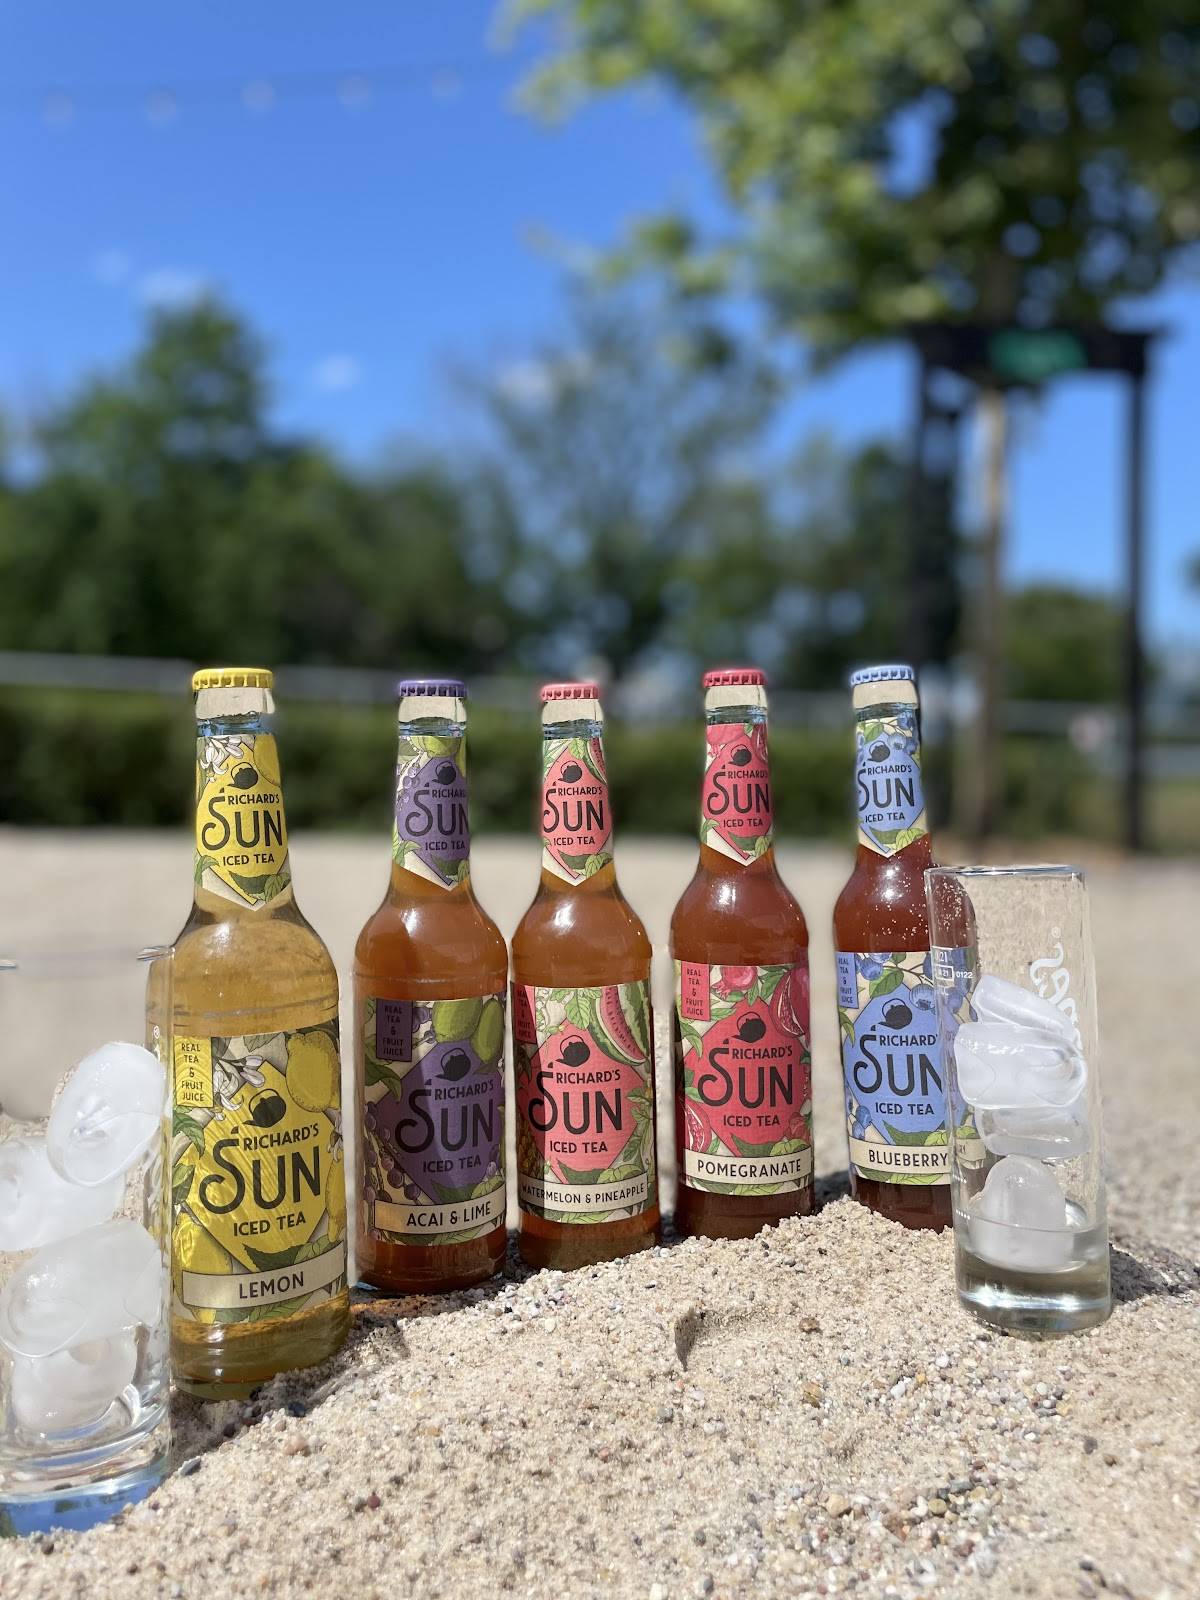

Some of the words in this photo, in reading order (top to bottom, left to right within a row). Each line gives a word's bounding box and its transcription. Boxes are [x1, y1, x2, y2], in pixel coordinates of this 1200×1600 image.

[868, 764, 913, 775] RICHARD'S
[557, 786, 603, 796] RICHARD'S
[707, 771, 770, 815] SUN
[857, 768, 915, 811] SUN
[228, 793, 280, 806] RICHARD'S
[405, 789, 470, 837] SUN
[543, 788, 604, 833] SUN
[865, 813, 884, 823] ICED
[886, 812, 906, 821] TEA
[201, 795, 284, 851] SUN
[723, 819, 744, 828] ICED
[746, 818, 764, 827] TEA
[425, 841, 448, 851] ICED
[450, 840, 466, 850] TEA
[553, 837, 574, 846] ICED
[576, 836, 596, 845] TEA
[222, 854, 250, 867] ICED
[253, 853, 275, 865] TEA
[686, 968, 702, 977] REAL
[955, 971, 973, 979] 0122
[688, 977, 700, 985] TEA
[685, 997, 704, 1007] FRUIT
[686, 1007, 704, 1016] JUICE
[386, 1015, 401, 1024] TEA
[181, 1043, 201, 1052] REAL
[879, 1034, 938, 1047] RICHARD'
[183, 1054, 199, 1063] TEA
[732, 1045, 793, 1060] RICHARD'S
[189, 1067, 195, 1078] &
[556, 1069, 621, 1085] RICHARD'S
[697, 1047, 793, 1109] SUN
[181, 1080, 204, 1091] FRUIT
[434, 1079, 494, 1101] RICHARD'S
[182, 1093, 204, 1102] JUICE
[527, 1071, 623, 1135] SUN
[875, 1102, 903, 1115] ICED
[907, 1103, 935, 1115] TEA
[395, 1089, 494, 1154] SUN
[723, 1115, 752, 1128] ICED
[756, 1115, 781, 1127] TEA
[243, 1123, 320, 1151] RICHARD'S
[549, 1140, 577, 1154] ICED
[581, 1141, 609, 1153] TEA
[422, 1159, 454, 1173] ICED
[458, 1154, 482, 1169] TEA
[868, 1149, 948, 1167] BLUEBERRY
[697, 1158, 802, 1179] POMEGRANATE
[198, 1139, 321, 1215] SUN
[521, 1184, 581, 1203] WATERMELON
[585, 1193, 592, 1204] &
[595, 1183, 645, 1203] PINEAPPLE
[406, 1212, 443, 1226] ACAI
[449, 1211, 458, 1225] &
[463, 1201, 491, 1222] LIME
[233, 1219, 271, 1237] ICED
[276, 1213, 307, 1231] TEA
[239, 1272, 304, 1300] LEMON
